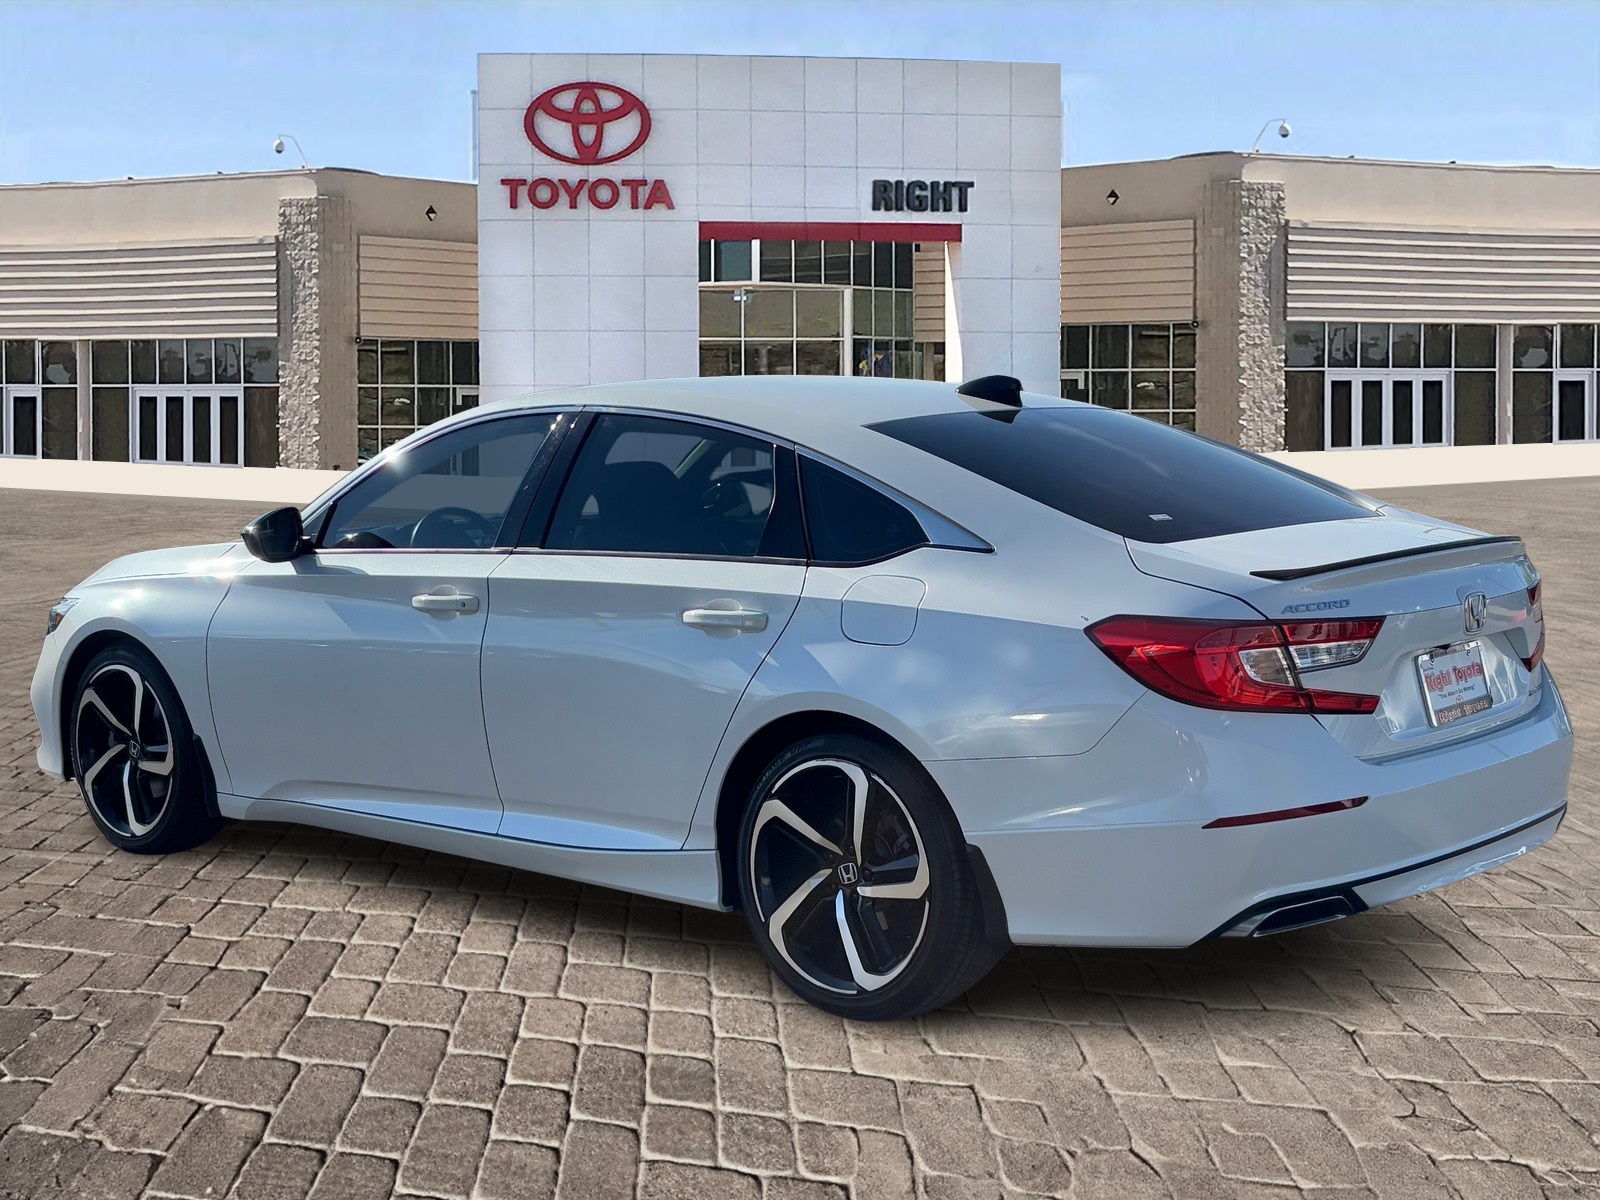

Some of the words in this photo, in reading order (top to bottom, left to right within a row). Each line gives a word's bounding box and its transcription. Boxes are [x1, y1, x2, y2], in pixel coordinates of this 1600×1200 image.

[500, 178, 675, 210] TOYOTA
[871, 179, 974, 213] RIGHT
[1280, 599, 1351, 615] ACCORD
[1424, 670, 1452, 692] Right
[1452, 661, 1483, 685] Toyota
[1439, 708, 1461, 723] Right
[1464, 699, 1488, 715] Toyota
